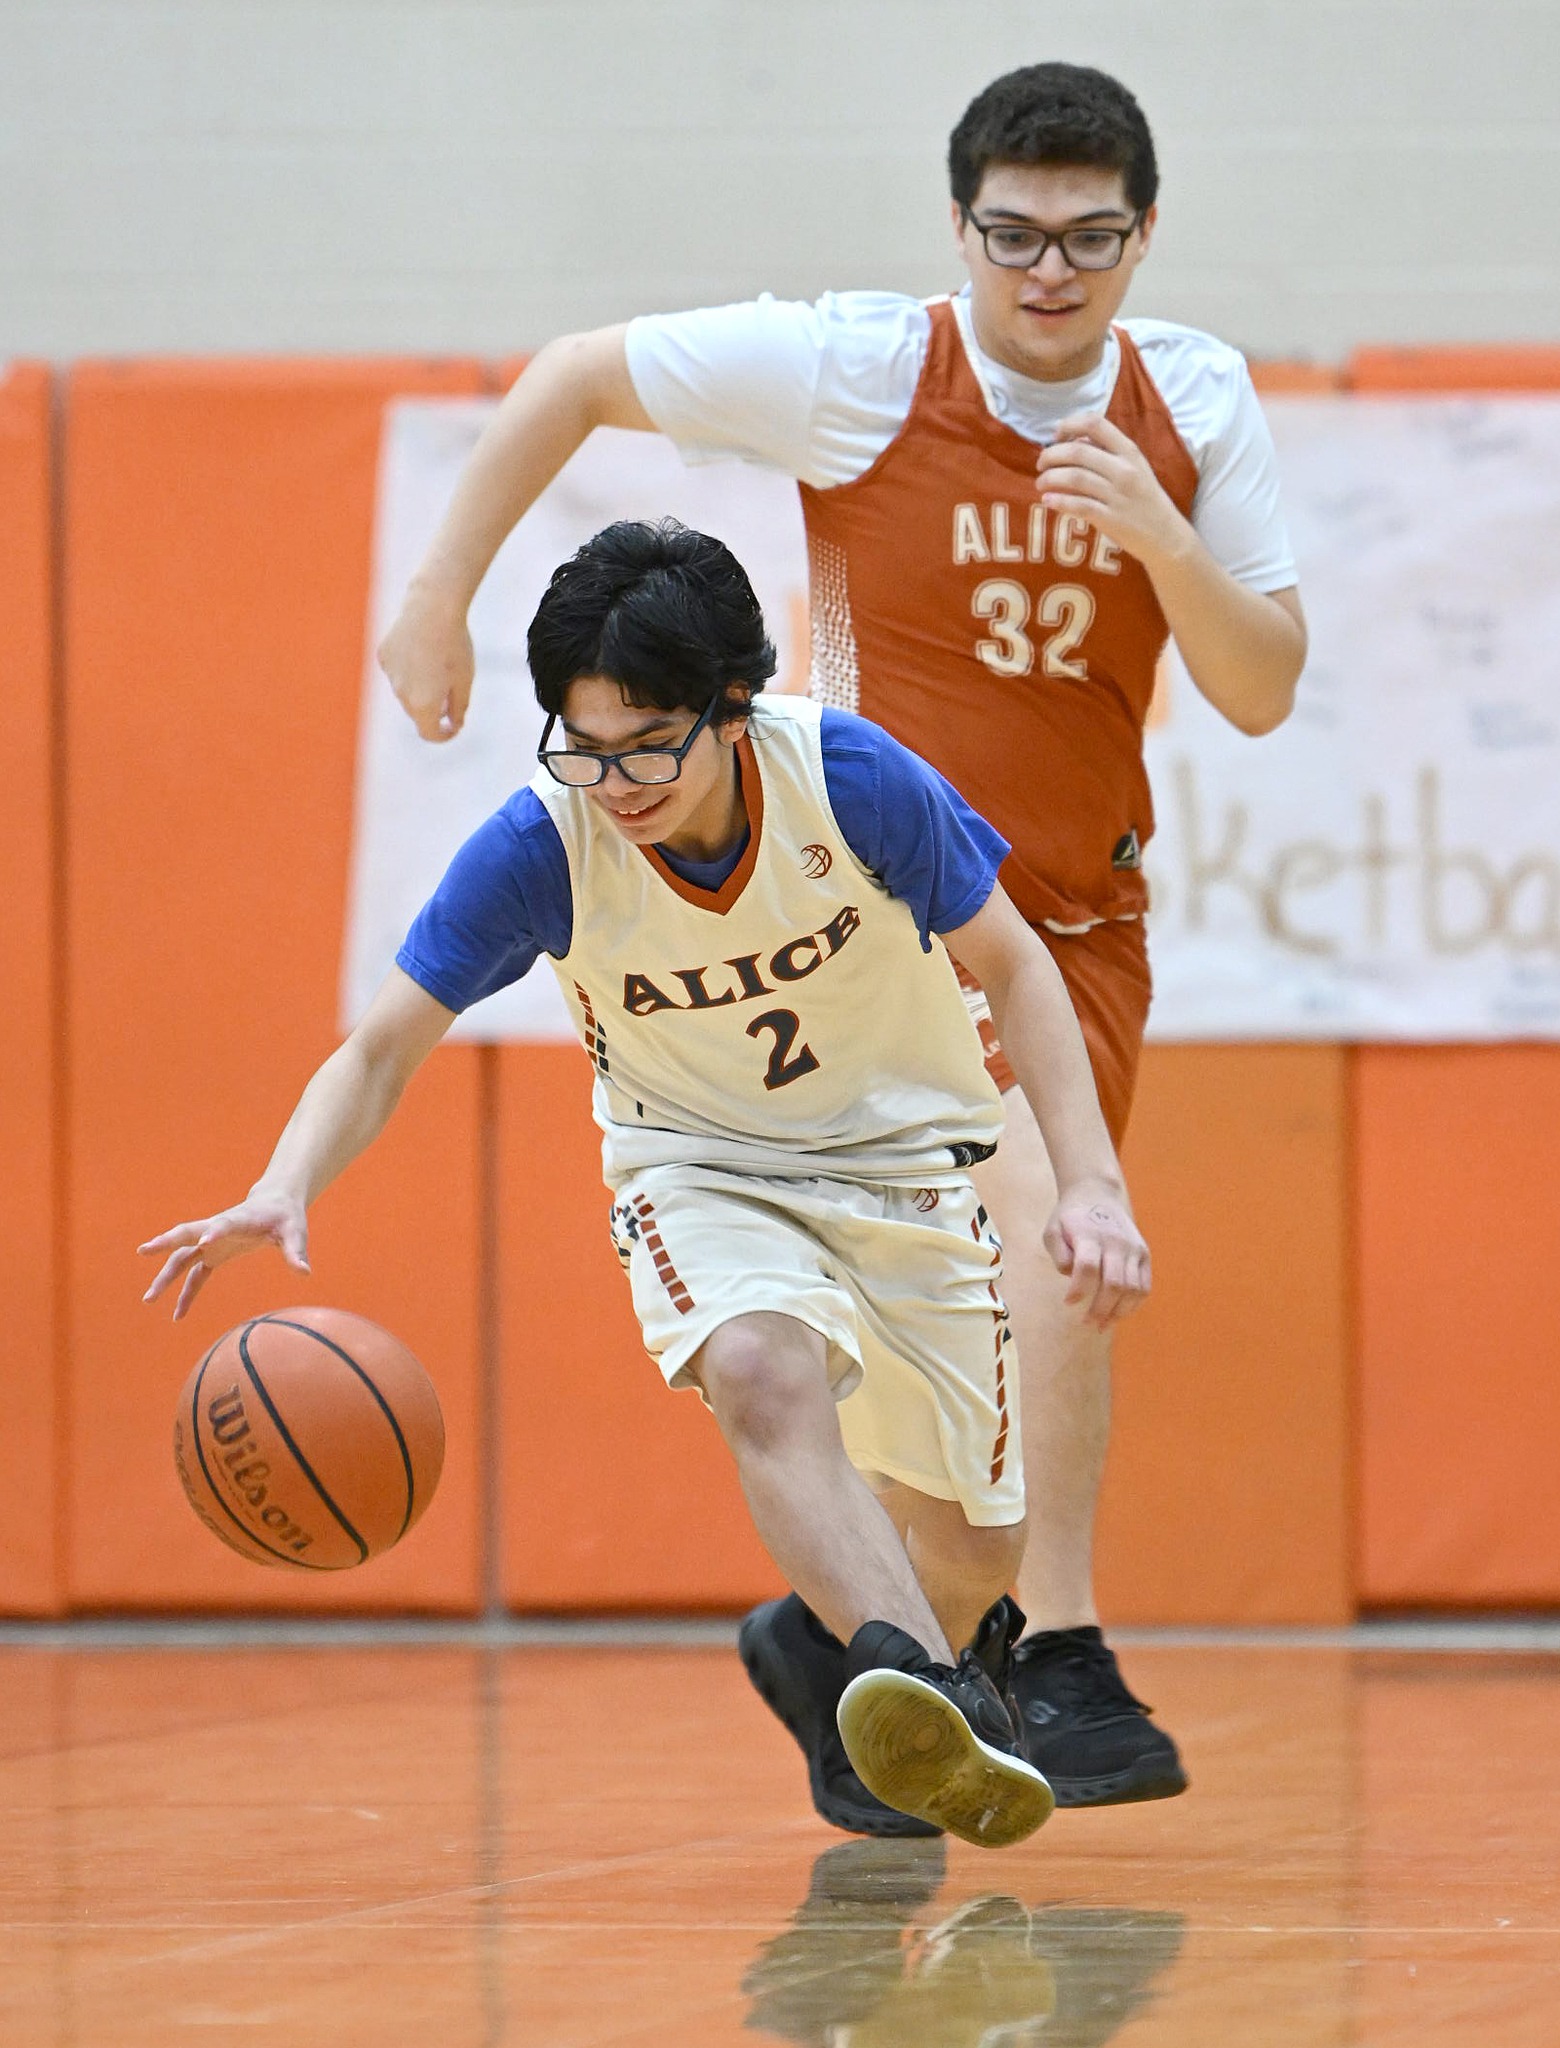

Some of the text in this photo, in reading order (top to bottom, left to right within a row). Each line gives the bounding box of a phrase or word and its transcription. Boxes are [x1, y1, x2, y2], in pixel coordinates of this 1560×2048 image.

[953, 502, 1122, 576] ALICE
[971, 577, 1096, 681] 32
[1150, 756, 1560, 960] ketba
[623, 906, 860, 1016] ALICE
[745, 1008, 820, 1090] 2
[208, 1383, 314, 1553] Wilson
